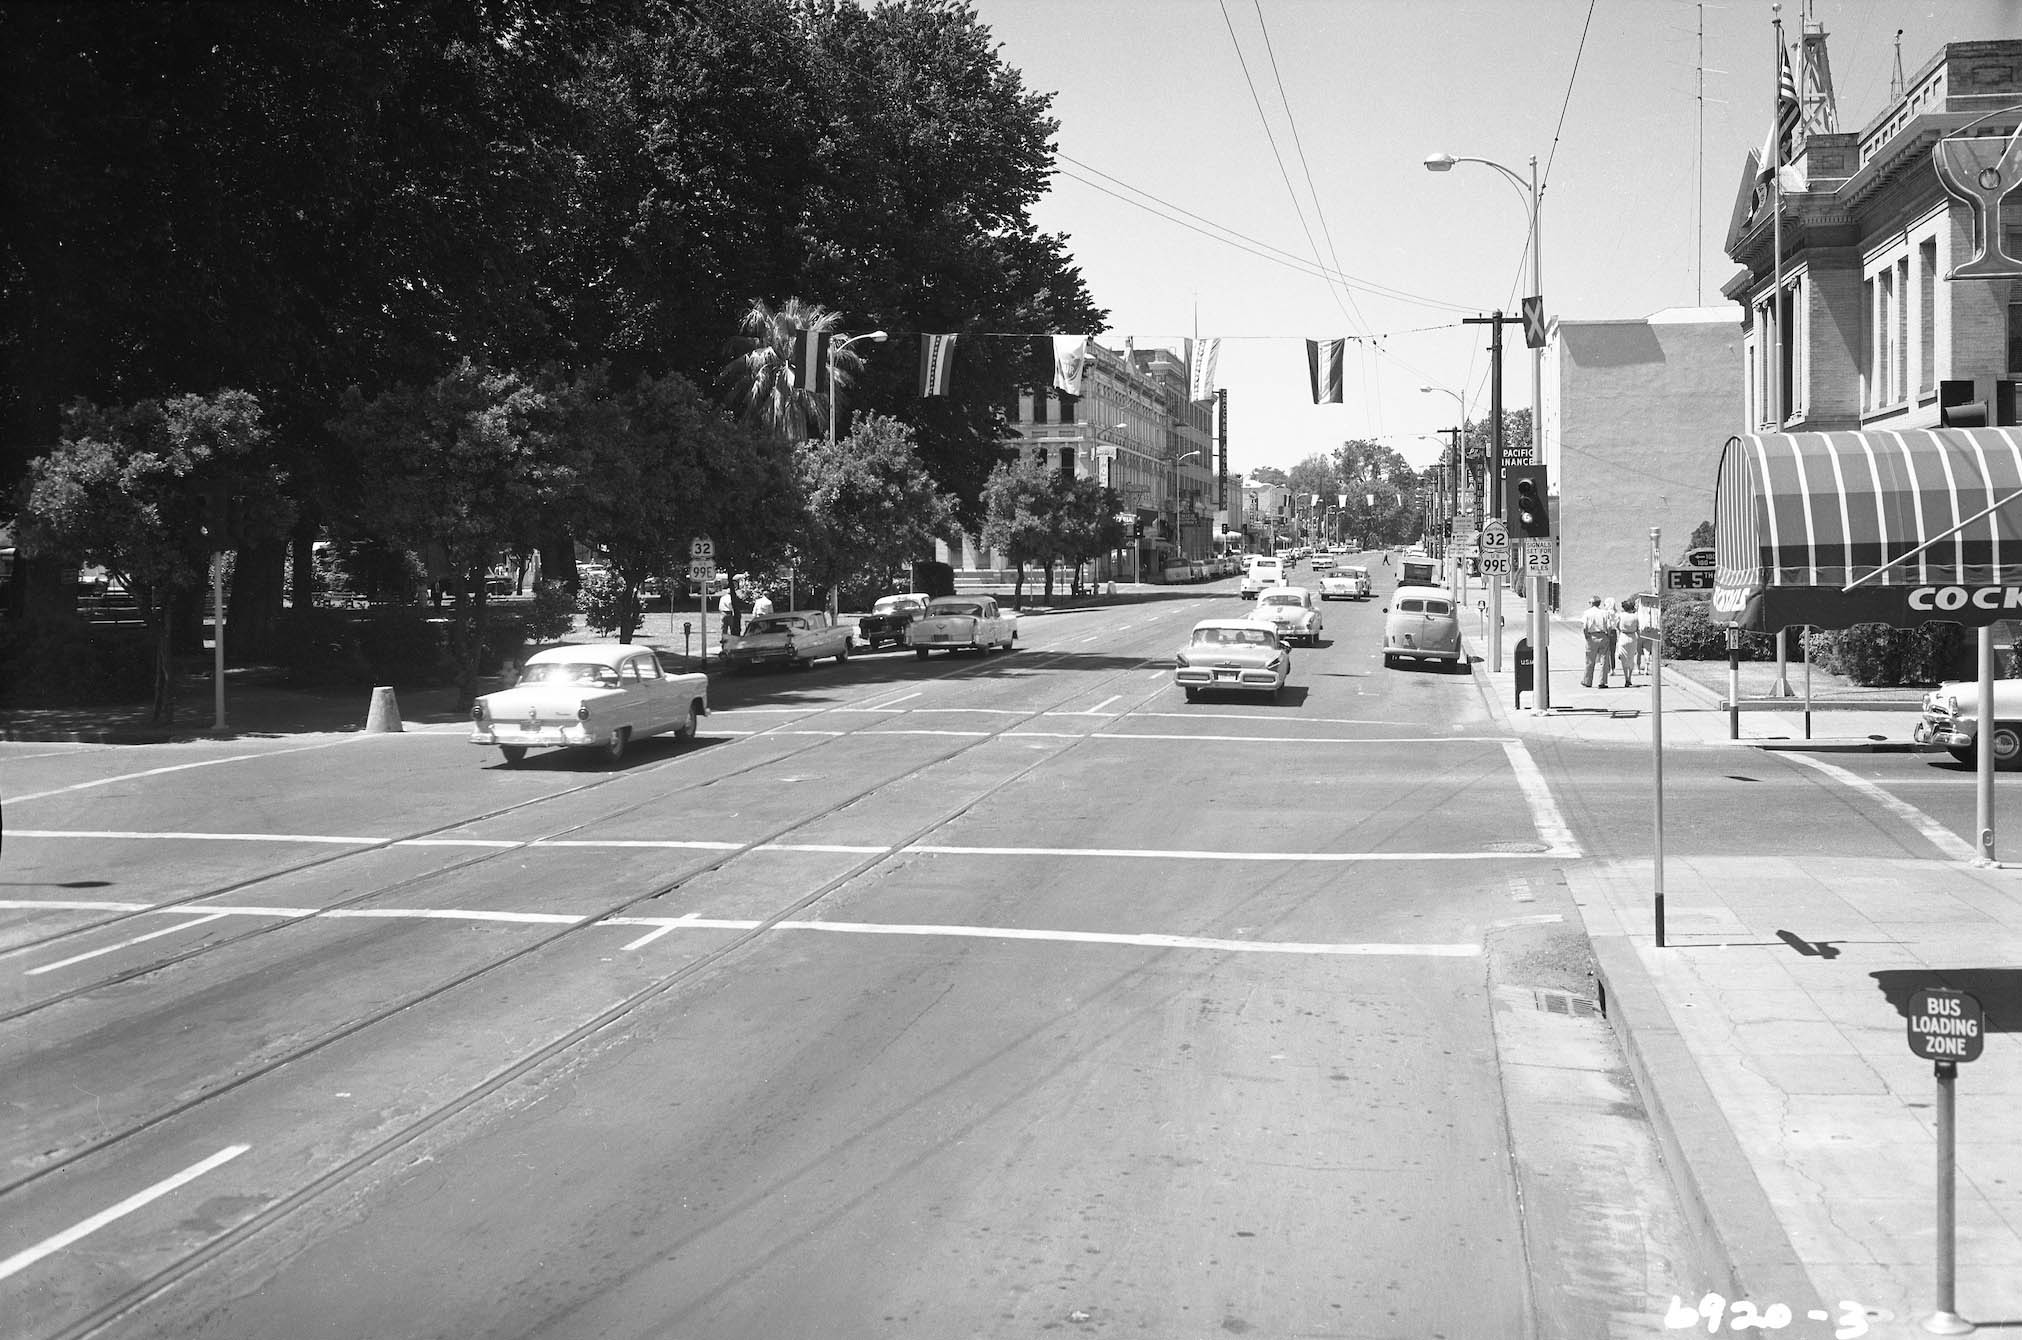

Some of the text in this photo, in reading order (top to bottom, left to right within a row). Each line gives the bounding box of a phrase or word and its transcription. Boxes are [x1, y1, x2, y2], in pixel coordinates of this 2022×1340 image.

[1503, 449, 1533, 457] PACIFIC
[1501, 458, 1534, 466] INANCE
[1486, 532, 1505, 546] 32
[694, 543, 711, 554] 32
[1483, 559, 1507, 573] 99E
[1528, 554, 1550, 565] 23
[693, 566, 713, 578] 99E
[1671, 572, 1714, 588] E. 5TH
[1908, 586, 2022, 610] COCK
[1927, 997, 1961, 1017] BUS
[1911, 1015, 1978, 1037] LOADING
[1926, 1035, 1967, 1056] ZONE
